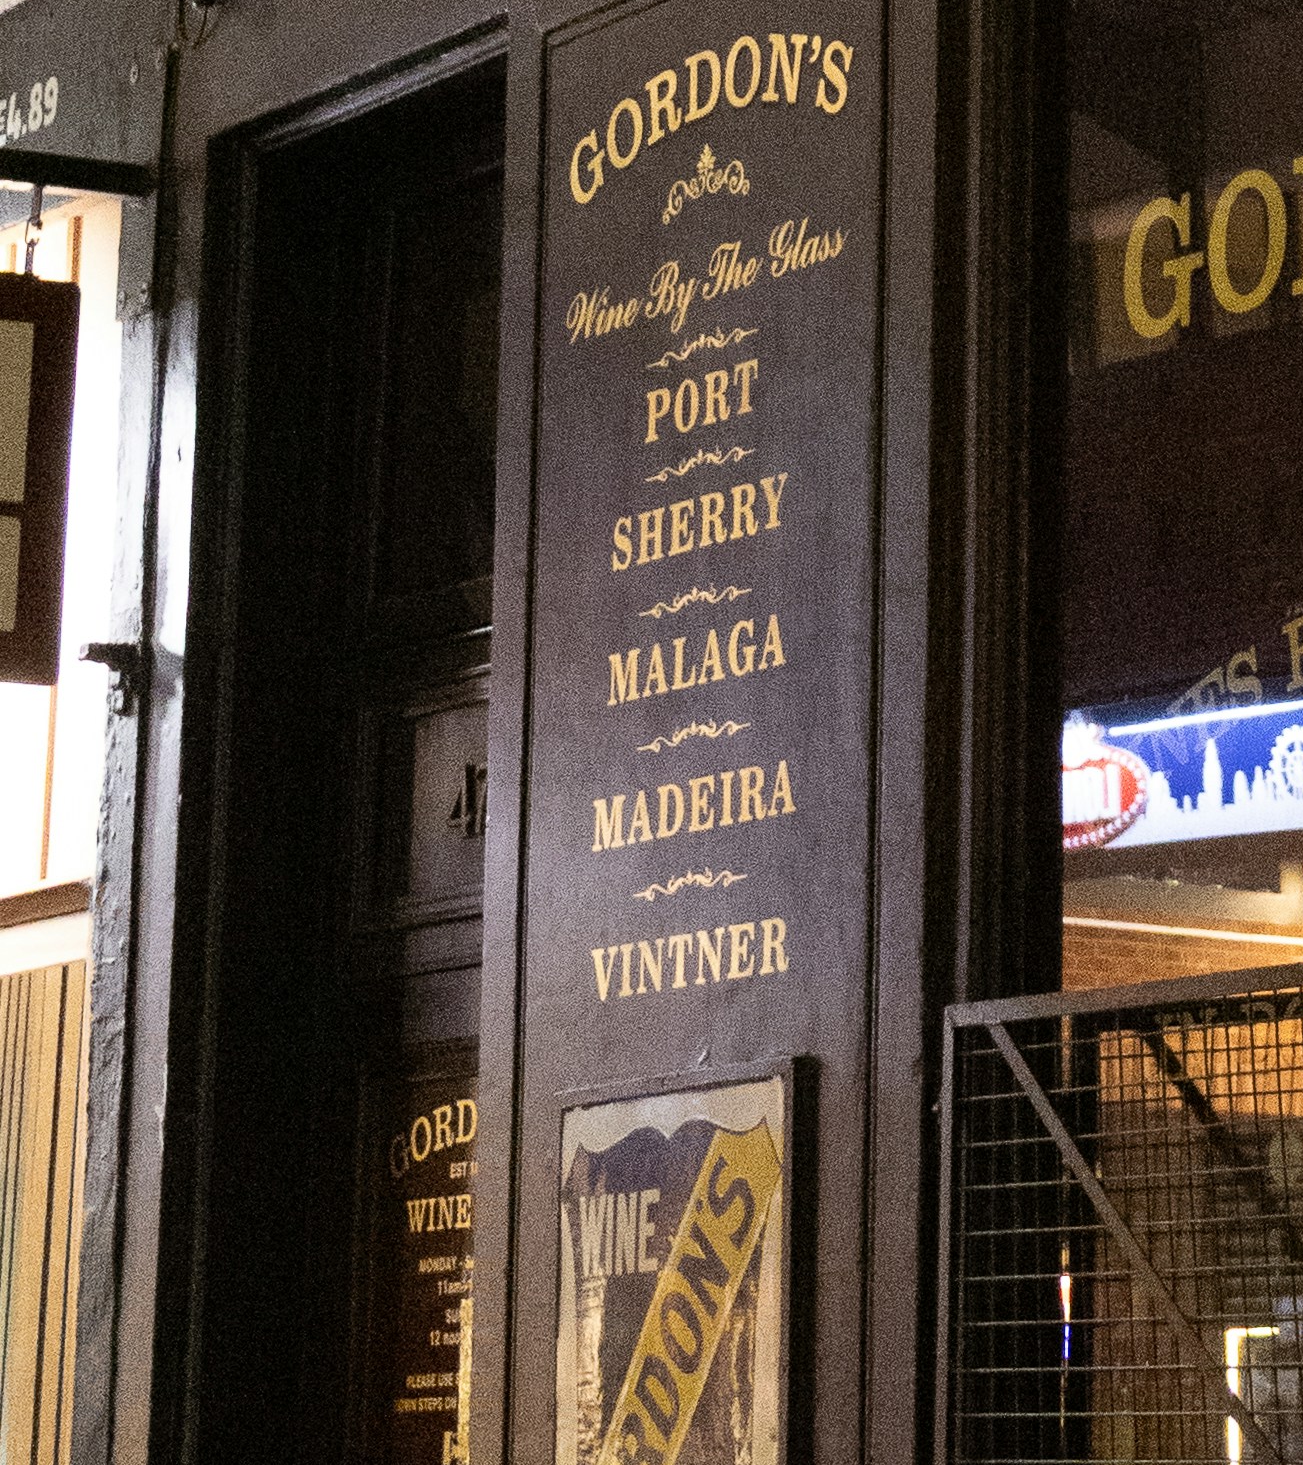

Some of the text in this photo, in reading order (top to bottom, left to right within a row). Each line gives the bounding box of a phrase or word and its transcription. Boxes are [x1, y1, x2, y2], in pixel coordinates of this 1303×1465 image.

[569, 32, 855, 205] GORDON'S
[566, 218, 849, 344] Wine By The Glass
[644, 358, 759, 444] PORT
[611, 473, 788, 572] SHERRY
[607, 614, 786, 707] MALAGA
[590, 759, 797, 853] MADEIRA
[590, 918, 790, 1002] VINTNER
[406, 1193, 472, 1234] WINE
[578, 1186, 662, 1277] WINE
